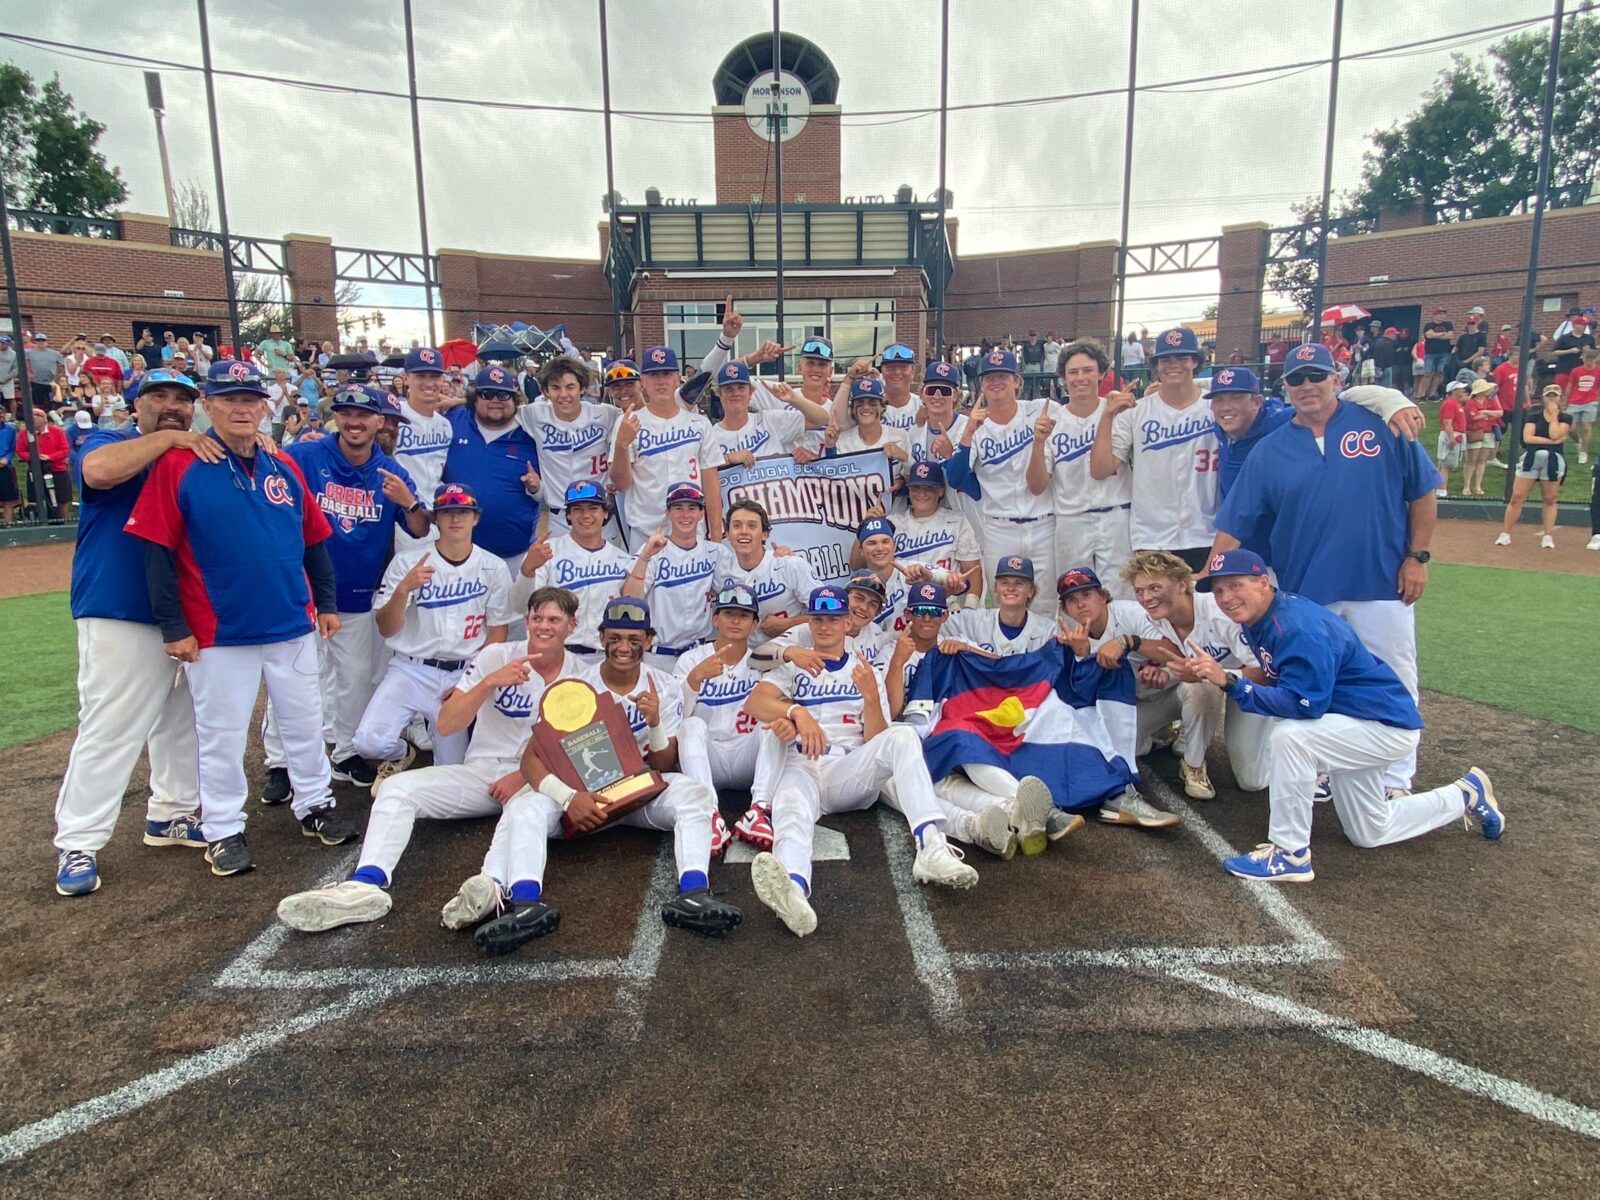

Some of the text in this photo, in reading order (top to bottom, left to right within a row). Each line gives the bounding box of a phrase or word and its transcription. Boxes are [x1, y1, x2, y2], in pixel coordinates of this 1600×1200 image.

[752, 88, 801, 96] MORNSON
[637, 426, 700, 450] Bruins
[1052, 424, 1096, 458] Brui
[1340, 430, 1381, 458] CC
[590, 453, 608, 475] 15
[688, 458, 698, 480] 3
[747, 465, 789, 479] HIGH
[794, 463, 861, 477] SCHOOL
[326, 481, 376, 507] CREEK
[320, 496, 378, 519] BASEBALL
[866, 520, 882, 531] 40
[556, 558, 628, 584] Bruins
[655, 556, 716, 582] Bruins
[417, 577, 488, 601] Bruins
[463, 614, 486, 640] 22
[793, 672, 863, 698] Bruins
